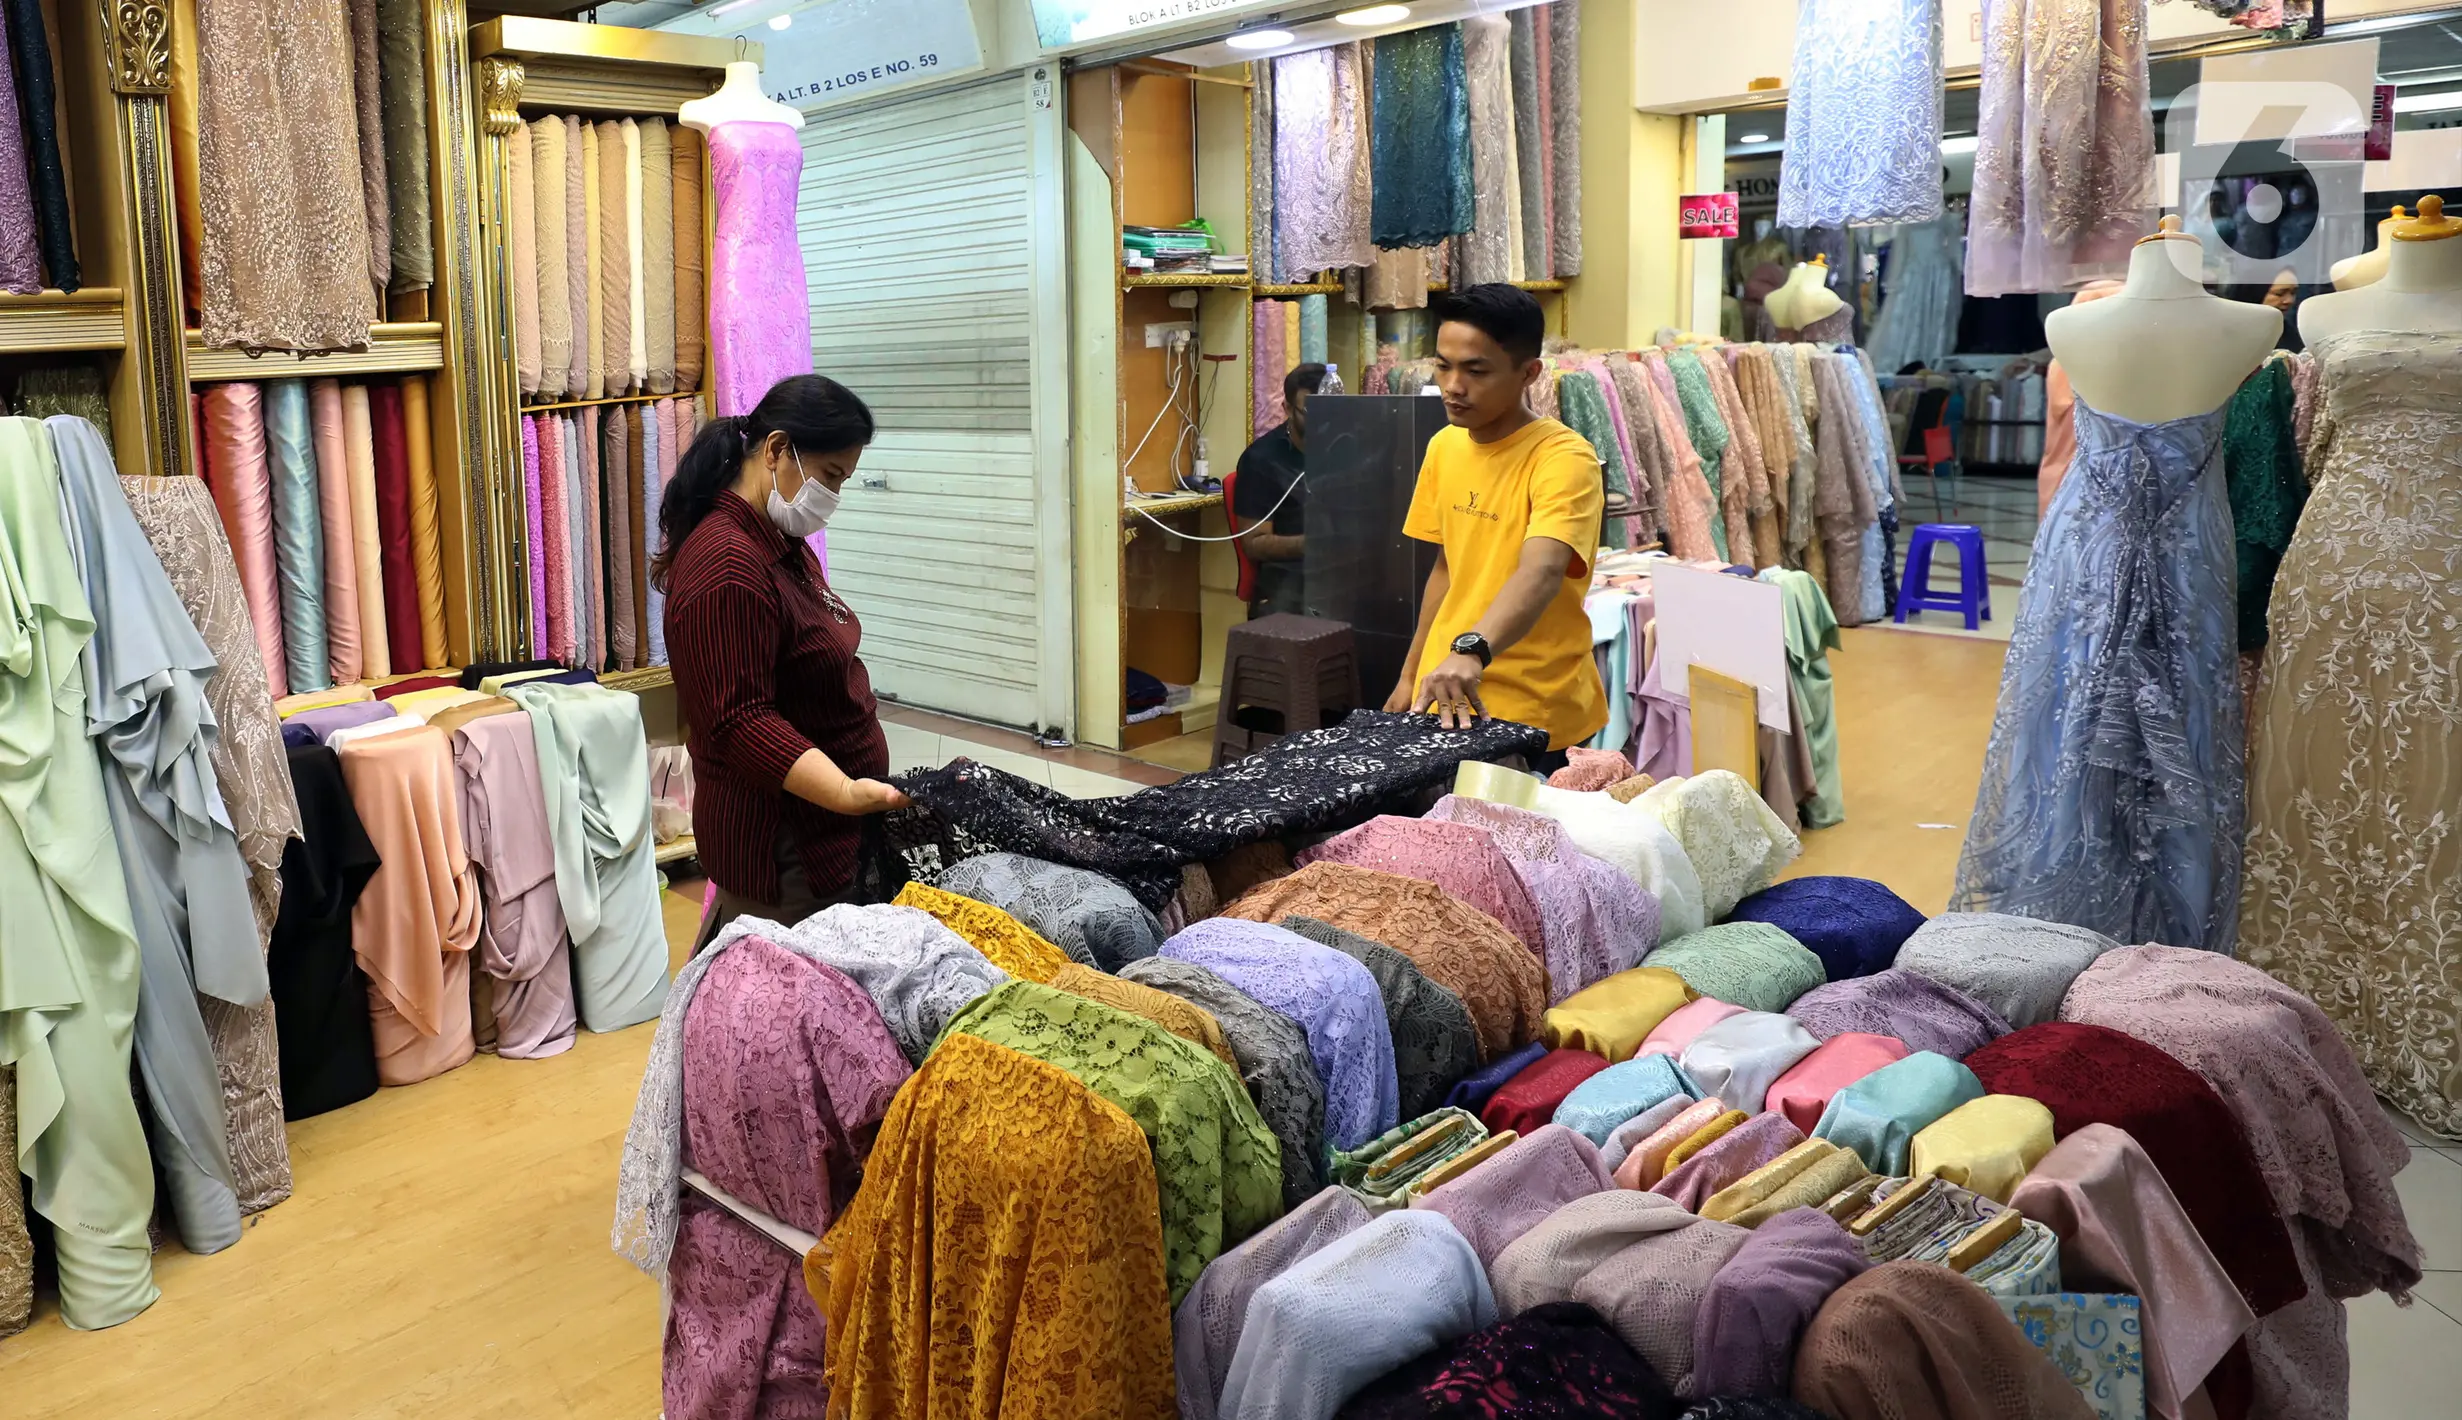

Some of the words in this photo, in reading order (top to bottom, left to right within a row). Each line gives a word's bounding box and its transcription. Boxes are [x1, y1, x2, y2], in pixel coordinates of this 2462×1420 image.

[1129, 12, 1155, 26] BLOK
[1160, 8, 1167, 18] A
[1187, 1, 1200, 12] B2
[776, 92, 787, 103] A
[788, 87, 807, 99] LT.
[810, 82, 821, 95] B
[824, 80, 833, 91] 2
[836, 71, 868, 88] LOS
[871, 67, 882, 79] E
[885, 59, 915, 76] NO.
[919, 53, 938, 67] 59
[1684, 206, 1734, 225] SALE
